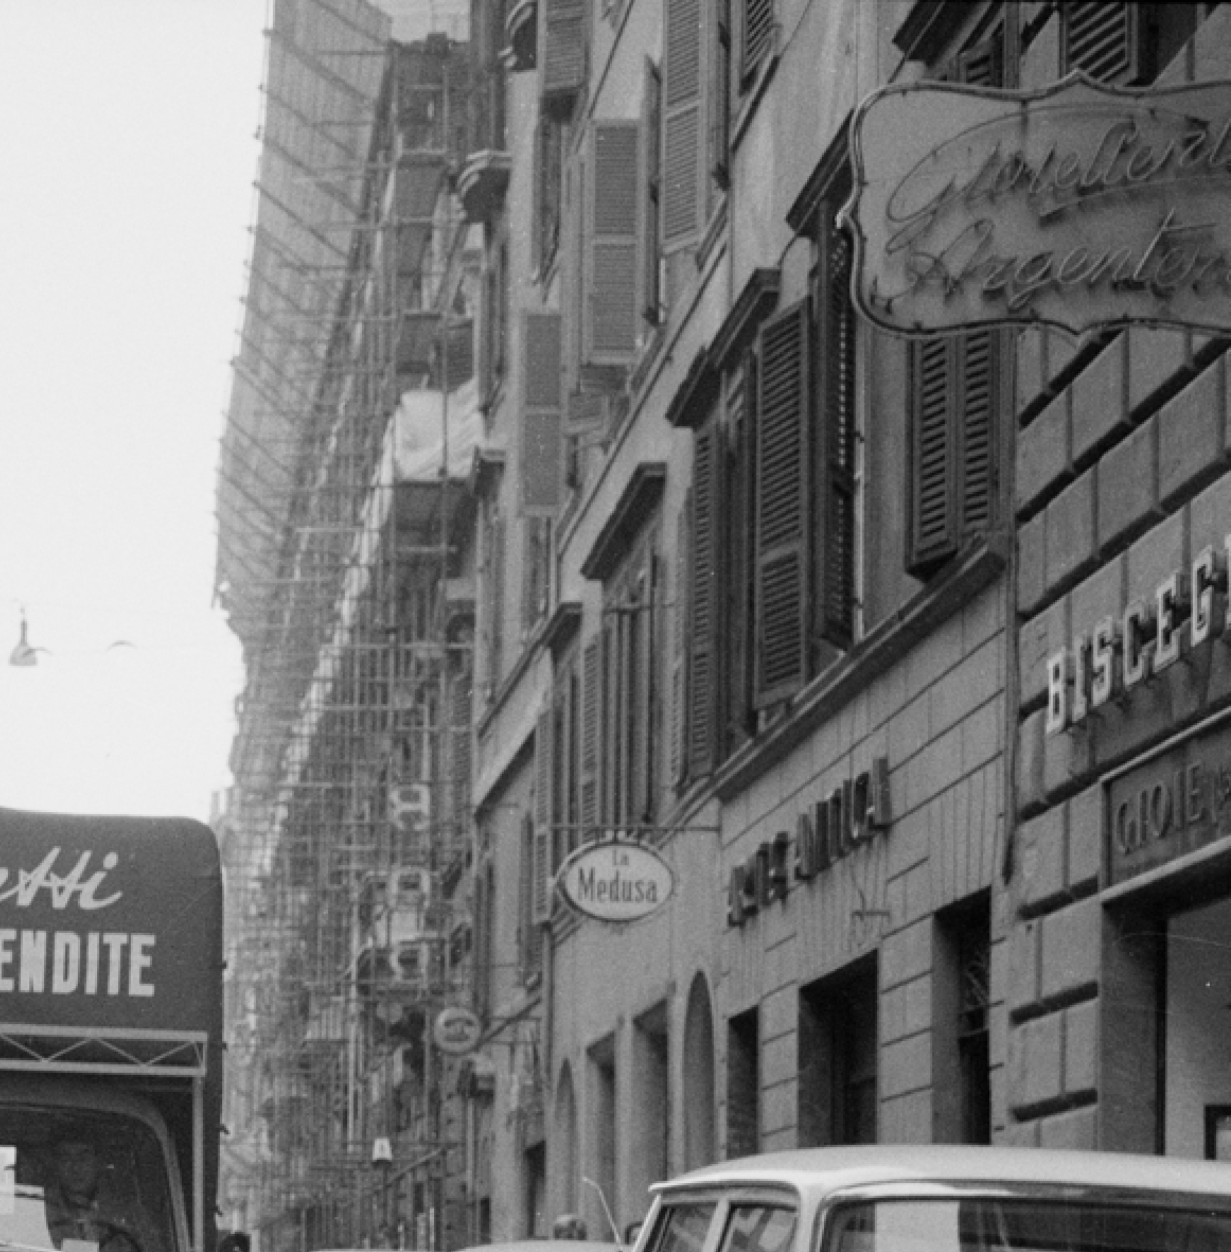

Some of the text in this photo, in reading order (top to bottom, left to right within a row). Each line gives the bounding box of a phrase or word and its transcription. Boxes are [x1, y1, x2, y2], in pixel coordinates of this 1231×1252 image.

[1046, 533, 1231, 736] BISCEG
[611, 847, 629, 866] La
[578, 866, 657, 903] Medusa
